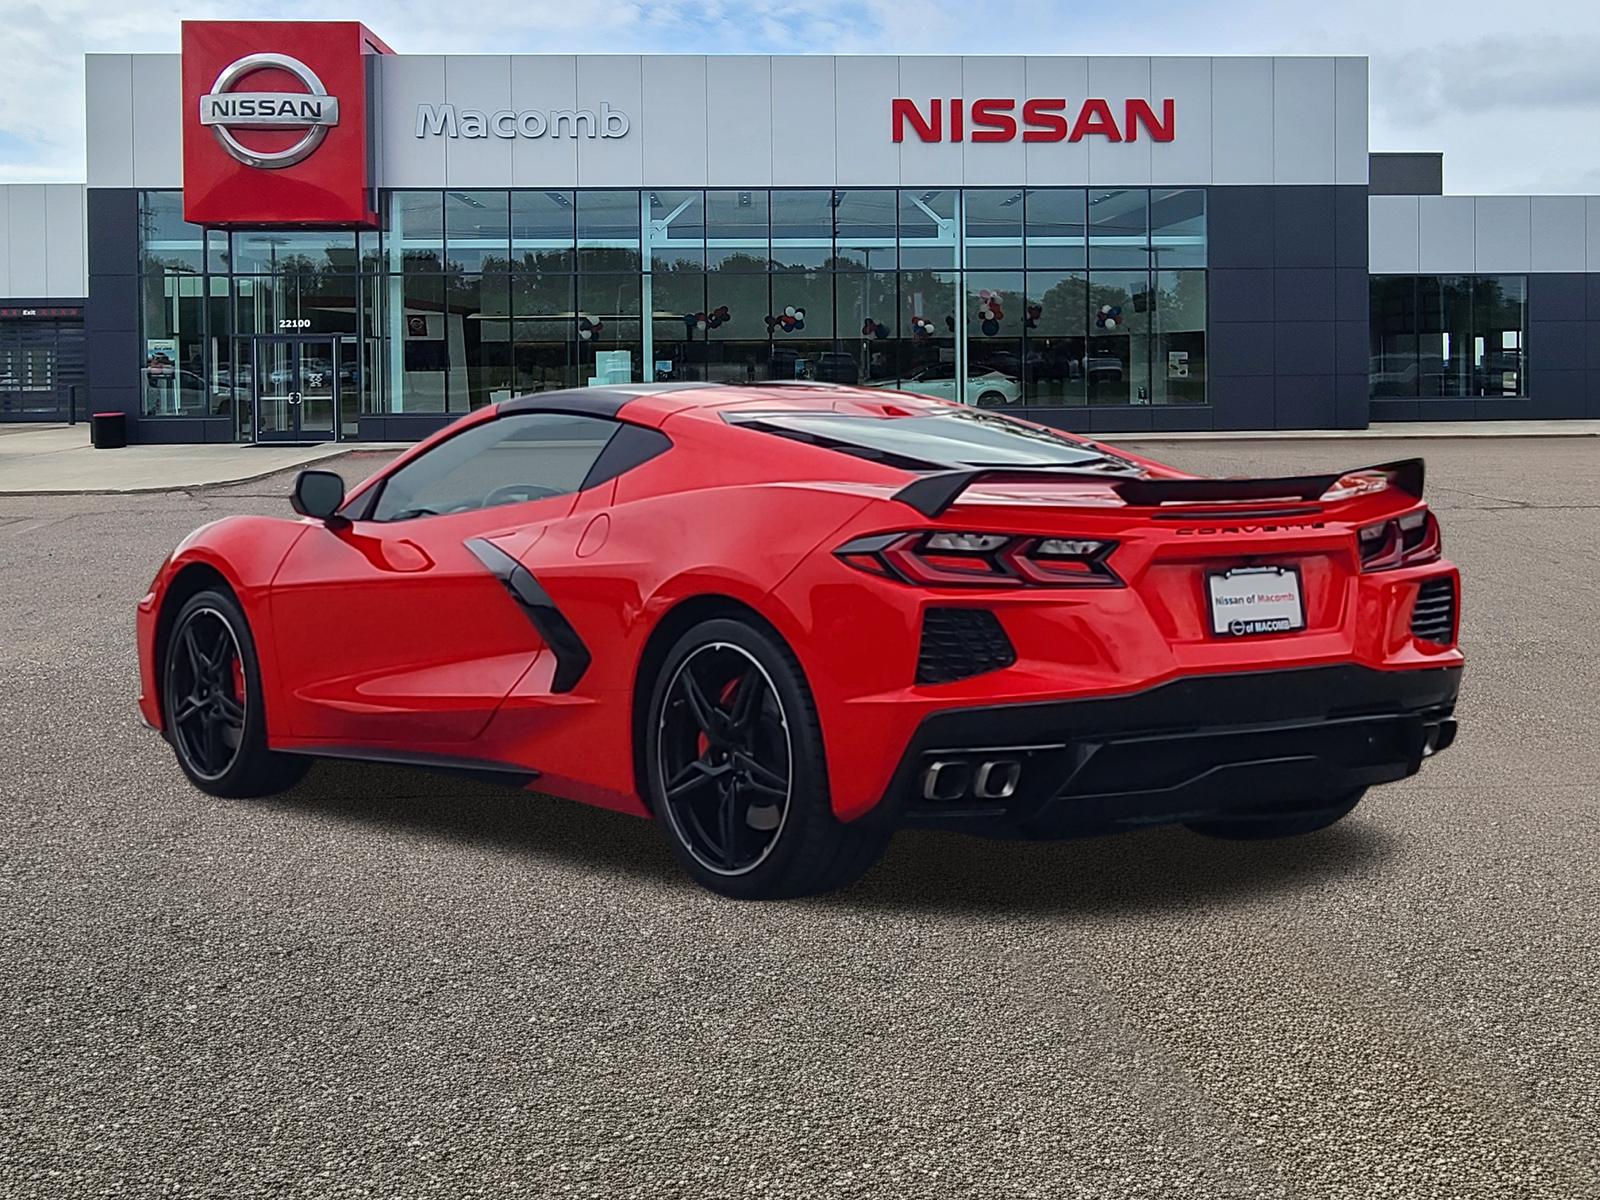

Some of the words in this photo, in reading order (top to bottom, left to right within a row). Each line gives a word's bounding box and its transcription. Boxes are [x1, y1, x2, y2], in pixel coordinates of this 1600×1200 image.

[211, 100, 322, 117] NISSAN
[415, 102, 630, 138] Macomb
[891, 98, 1175, 143] NISSAN
[279, 319, 311, 328] 22100
[1175, 522, 1325, 535] CORVETTE
[1215, 595, 1244, 606] Nissan
[1246, 594, 1255, 604] of
[1257, 592, 1295, 603] Macomb
[1255, 620, 1290, 631] MACOMB
